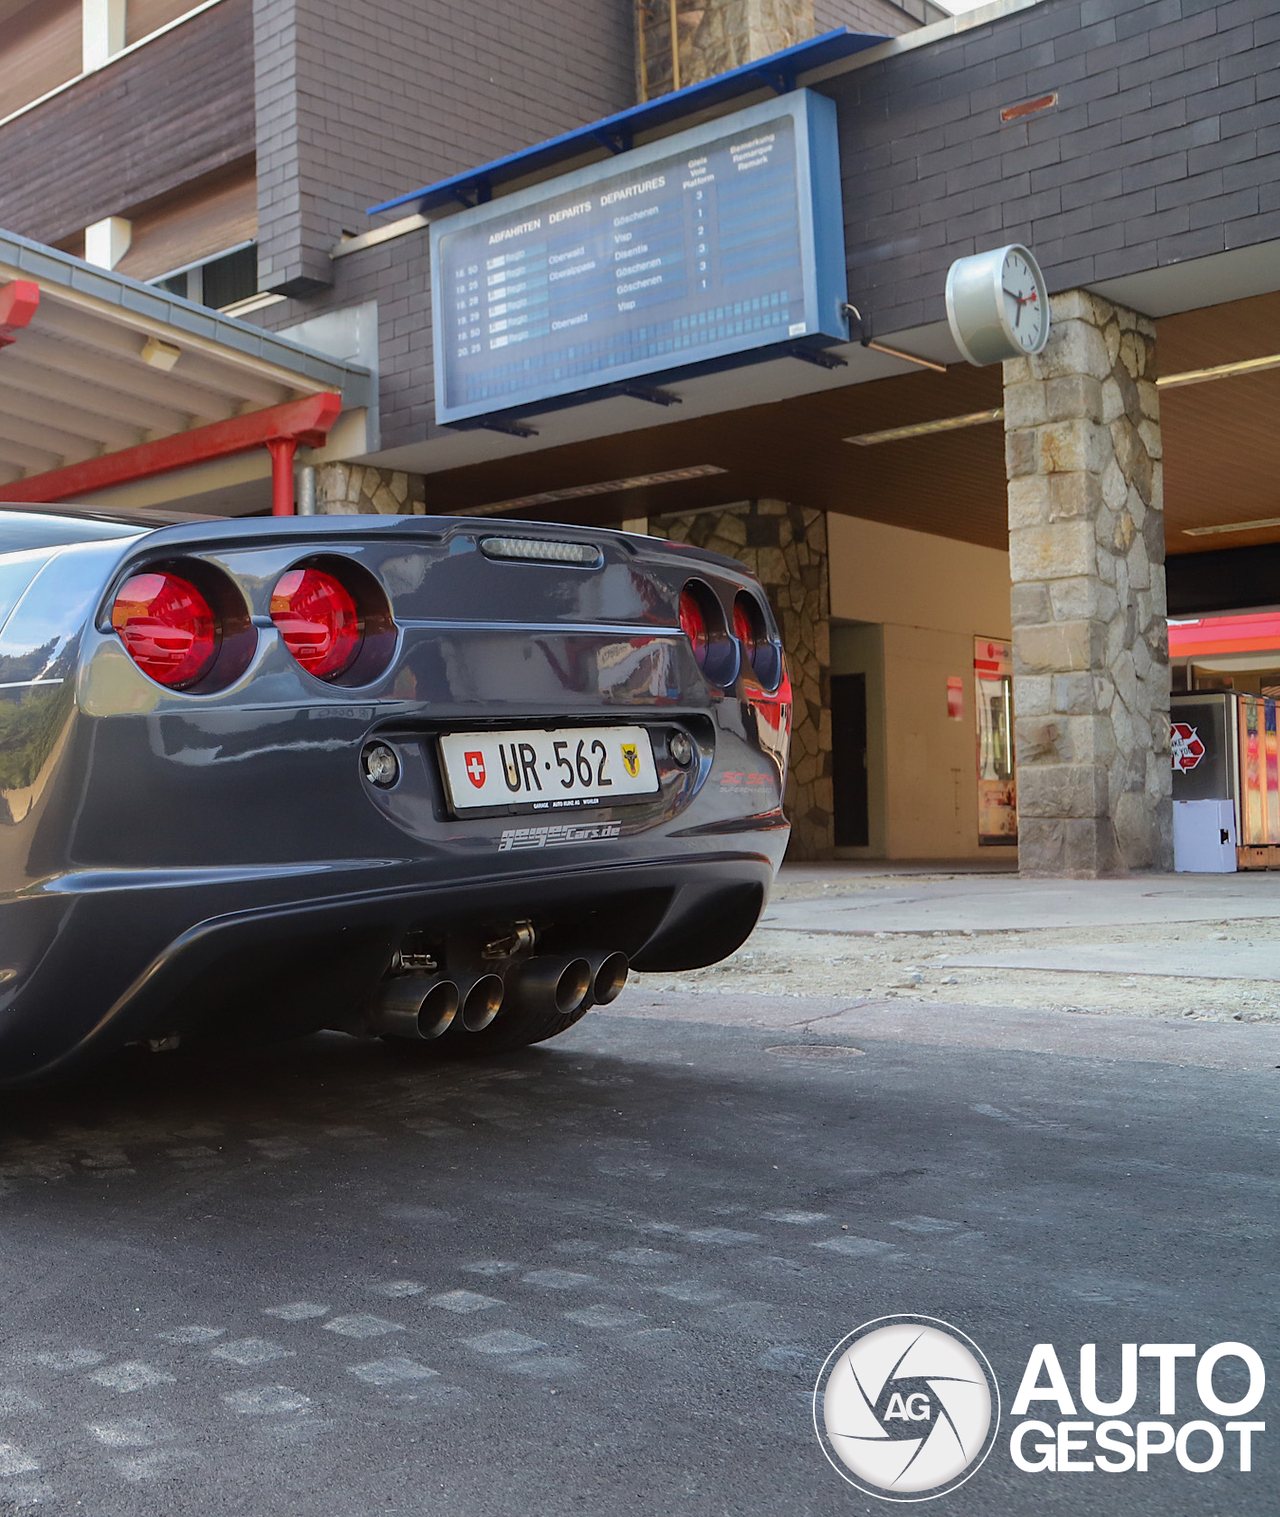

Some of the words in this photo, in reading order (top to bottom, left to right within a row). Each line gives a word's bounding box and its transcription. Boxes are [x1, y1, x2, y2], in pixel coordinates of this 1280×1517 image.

[730, 133, 775, 154] Bemerkung
[732, 144, 773, 163] Remarque
[687, 156, 708, 169] Gleis
[690, 167, 707, 178] Voie
[738, 156, 768, 171] Remark
[682, 174, 715, 190] Platform
[488, 219, 541, 245] ABFAHRTEN
[548, 201, 592, 225] DEPARTS
[600, 176, 666, 208] DEPARTURES
[613, 206, 659, 227] Göschenen
[696, 190, 703, 200] 3
[548, 246, 585, 265] Oberwald
[614, 232, 632, 244] Visp
[697, 208, 702, 218] 1
[549, 260, 596, 281] Oberalppass
[614, 244, 648, 261] Disentis
[697, 226, 704, 236] 2
[616, 258, 661, 278] Göschenen
[699, 243, 705, 253] 3
[616, 275, 662, 295] Göschenen
[700, 261, 706, 271] 3
[551, 312, 588, 331] Oberwald
[617, 300, 636, 312] Visp
[701, 279, 706, 288] 1
